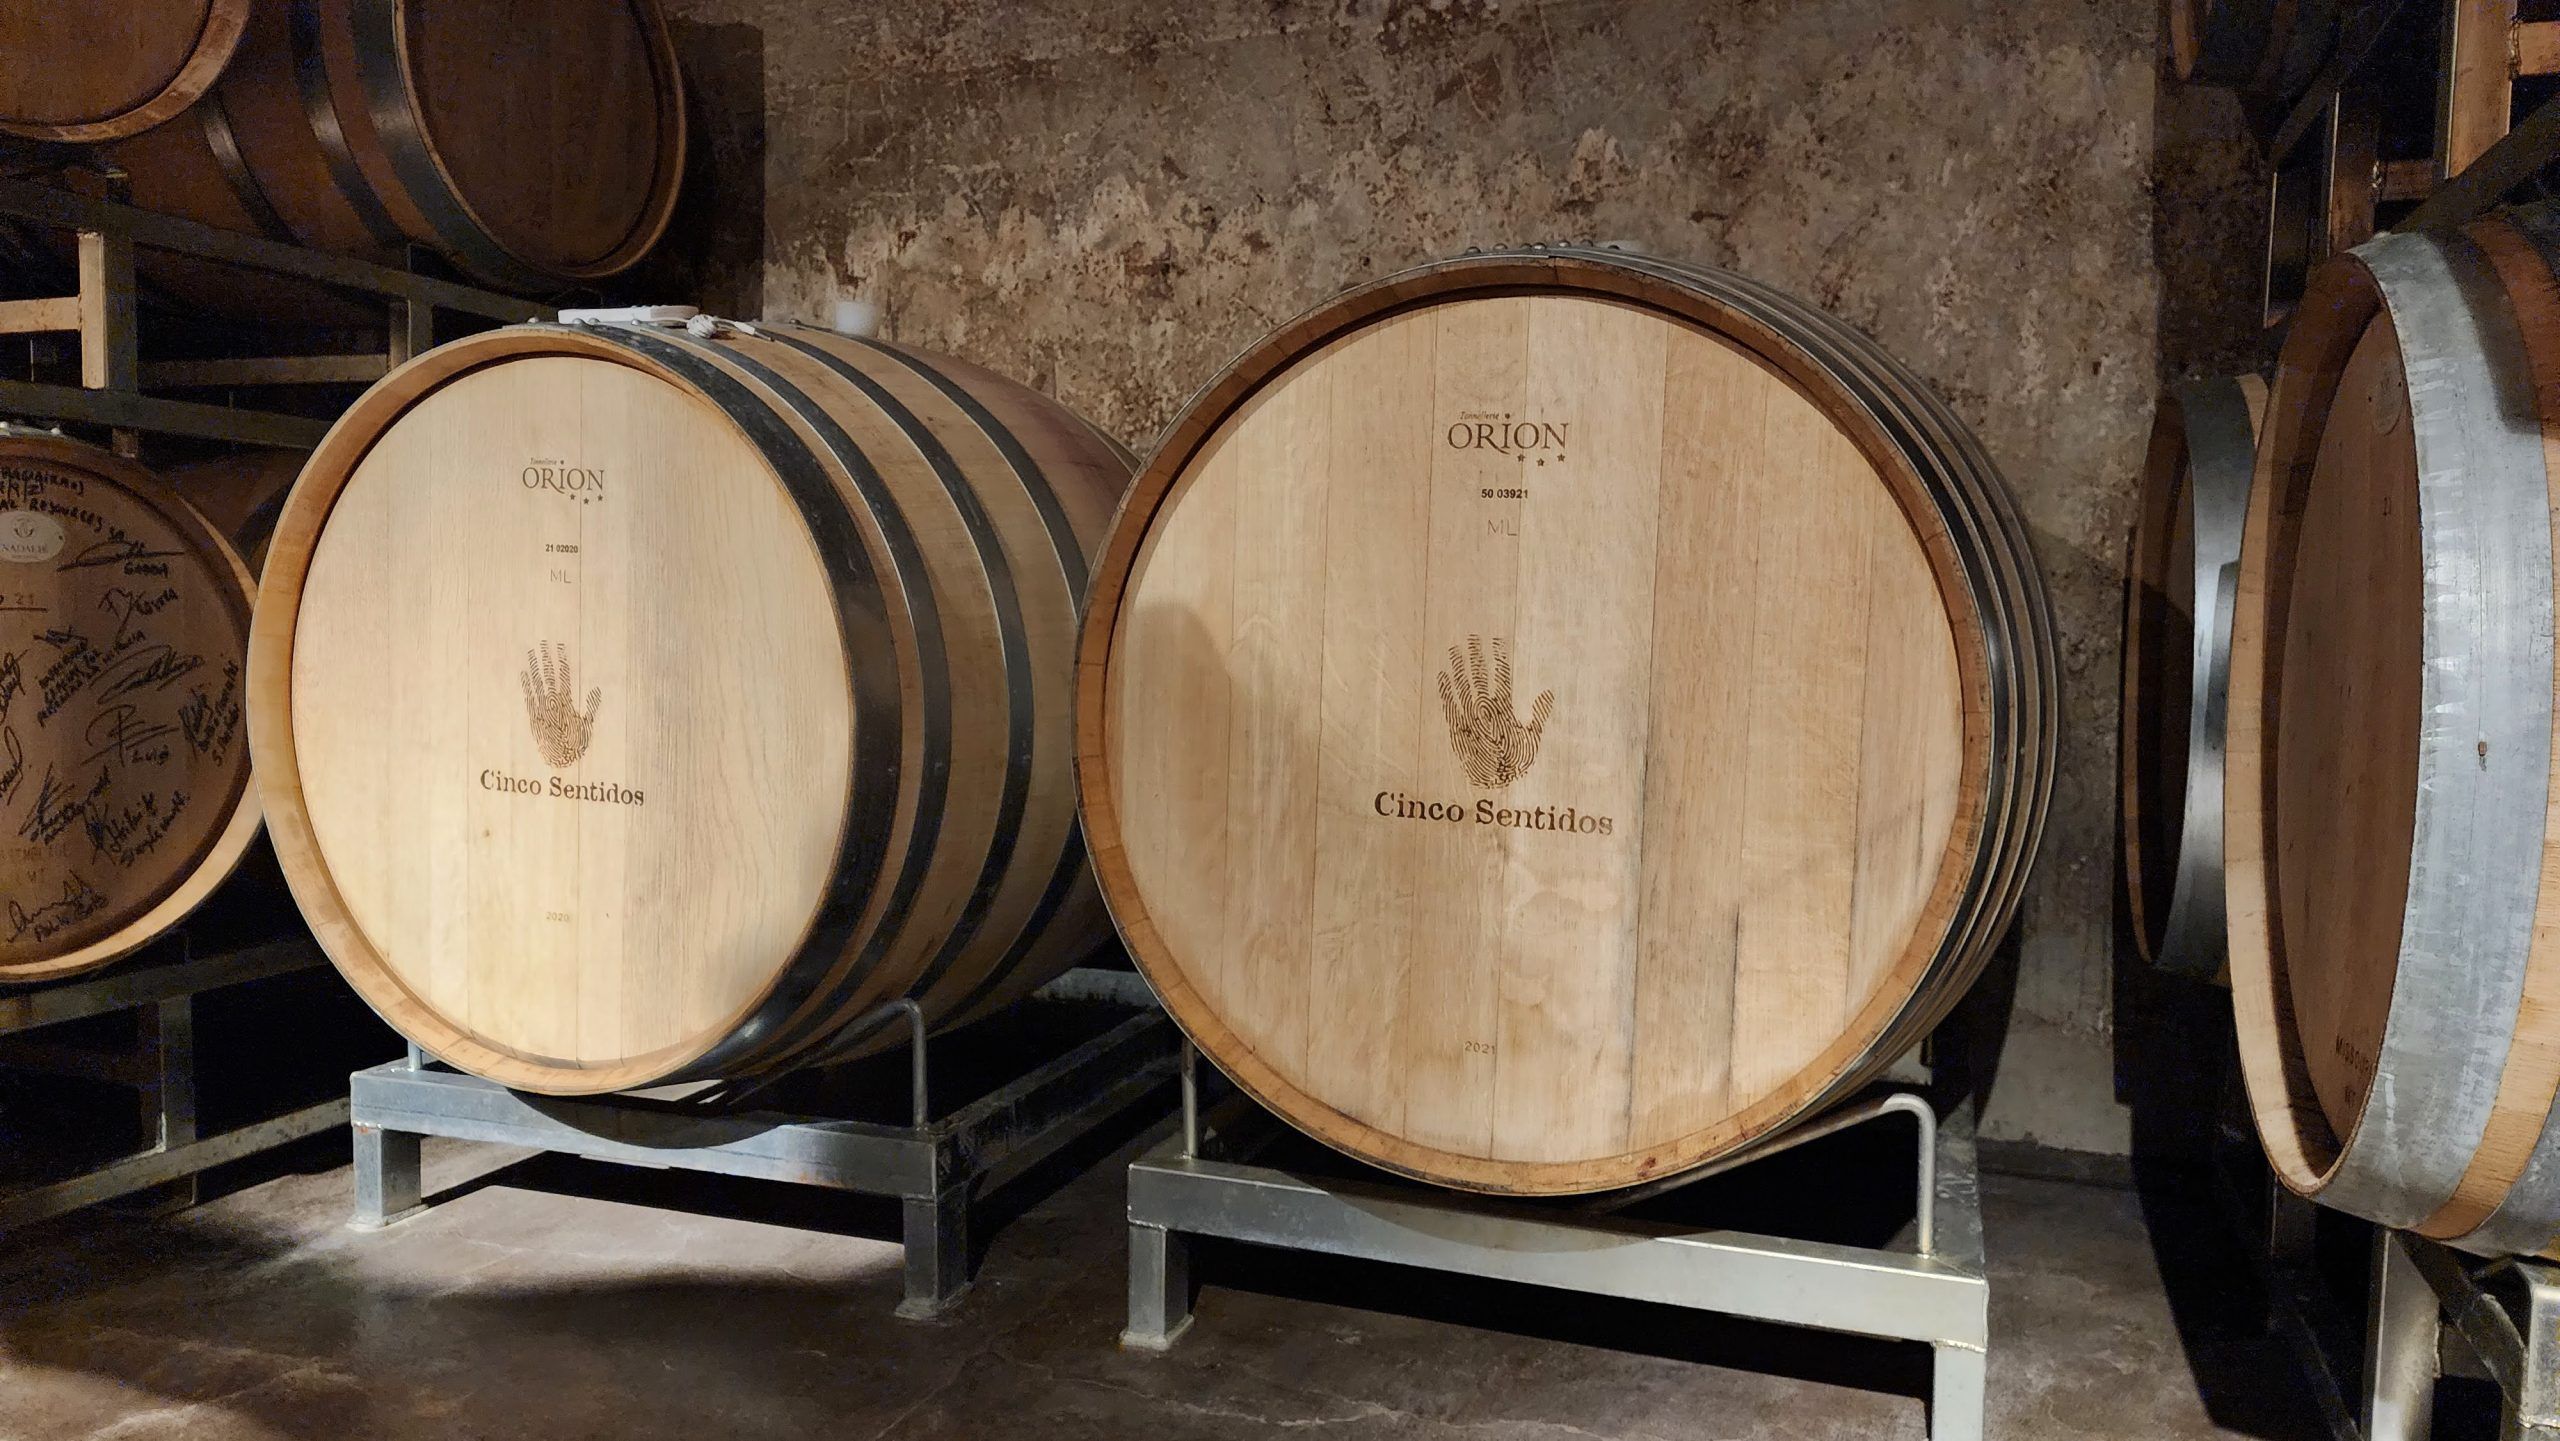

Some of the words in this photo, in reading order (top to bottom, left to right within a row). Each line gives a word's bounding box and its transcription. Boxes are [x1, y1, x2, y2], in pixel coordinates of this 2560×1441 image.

[1447, 422, 1569, 455] ORION
[522, 466, 605, 495] ORION
[1481, 488, 1494, 499] 50
[1496, 488, 1529, 499] 03921
[1487, 519, 1518, 536] ML
[545, 543, 554, 553] 21
[555, 544, 579, 554] 02020
[550, 568, 572, 584] ML
[480, 768, 542, 796] Cinco
[549, 775, 645, 807] Sentidos
[1374, 790, 1465, 823] Cinco
[1475, 799, 1614, 836] Sentidos
[1464, 1041, 1497, 1055] 2021
